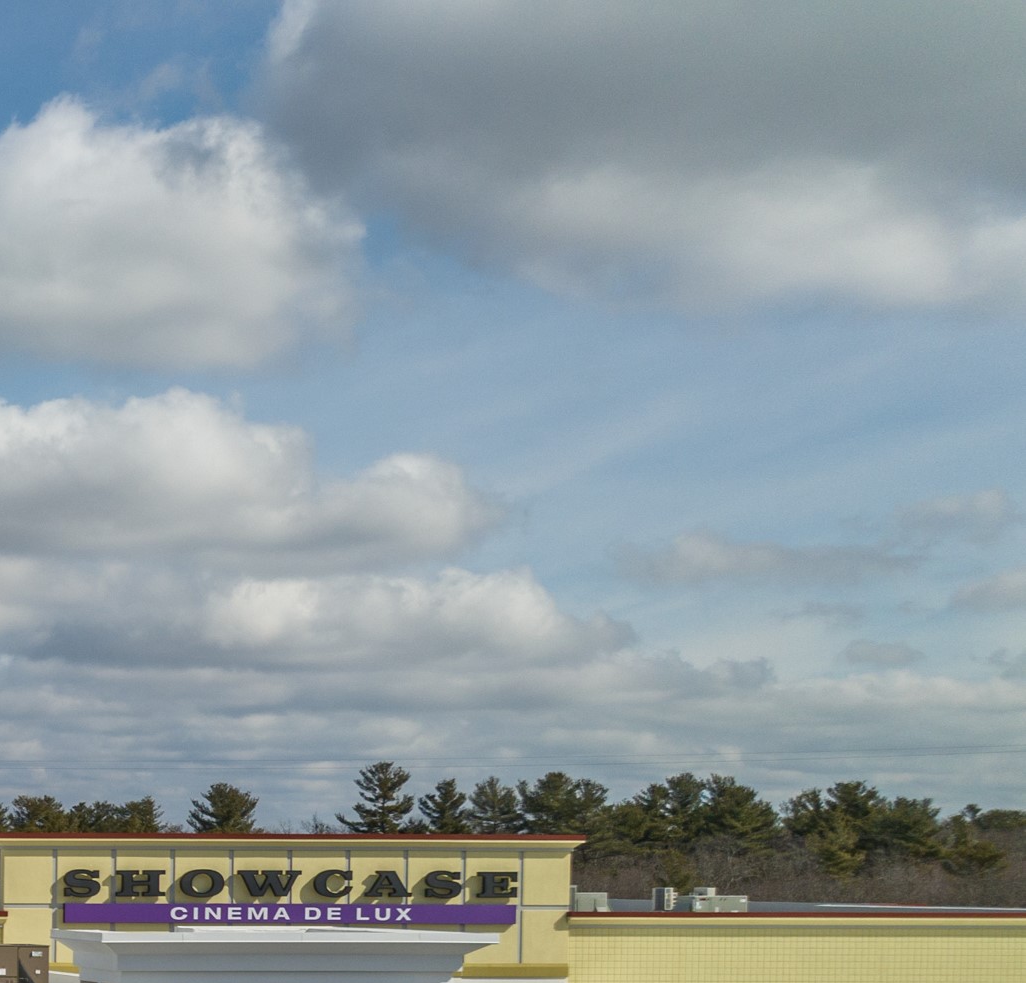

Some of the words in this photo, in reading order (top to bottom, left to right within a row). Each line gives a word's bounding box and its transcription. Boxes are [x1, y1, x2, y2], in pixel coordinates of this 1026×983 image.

[63, 869, 519, 898] SHOWCASE
[170, 907, 291, 921] CINEMA
[304, 907, 343, 921] DE
[356, 907, 413, 921] LUX
